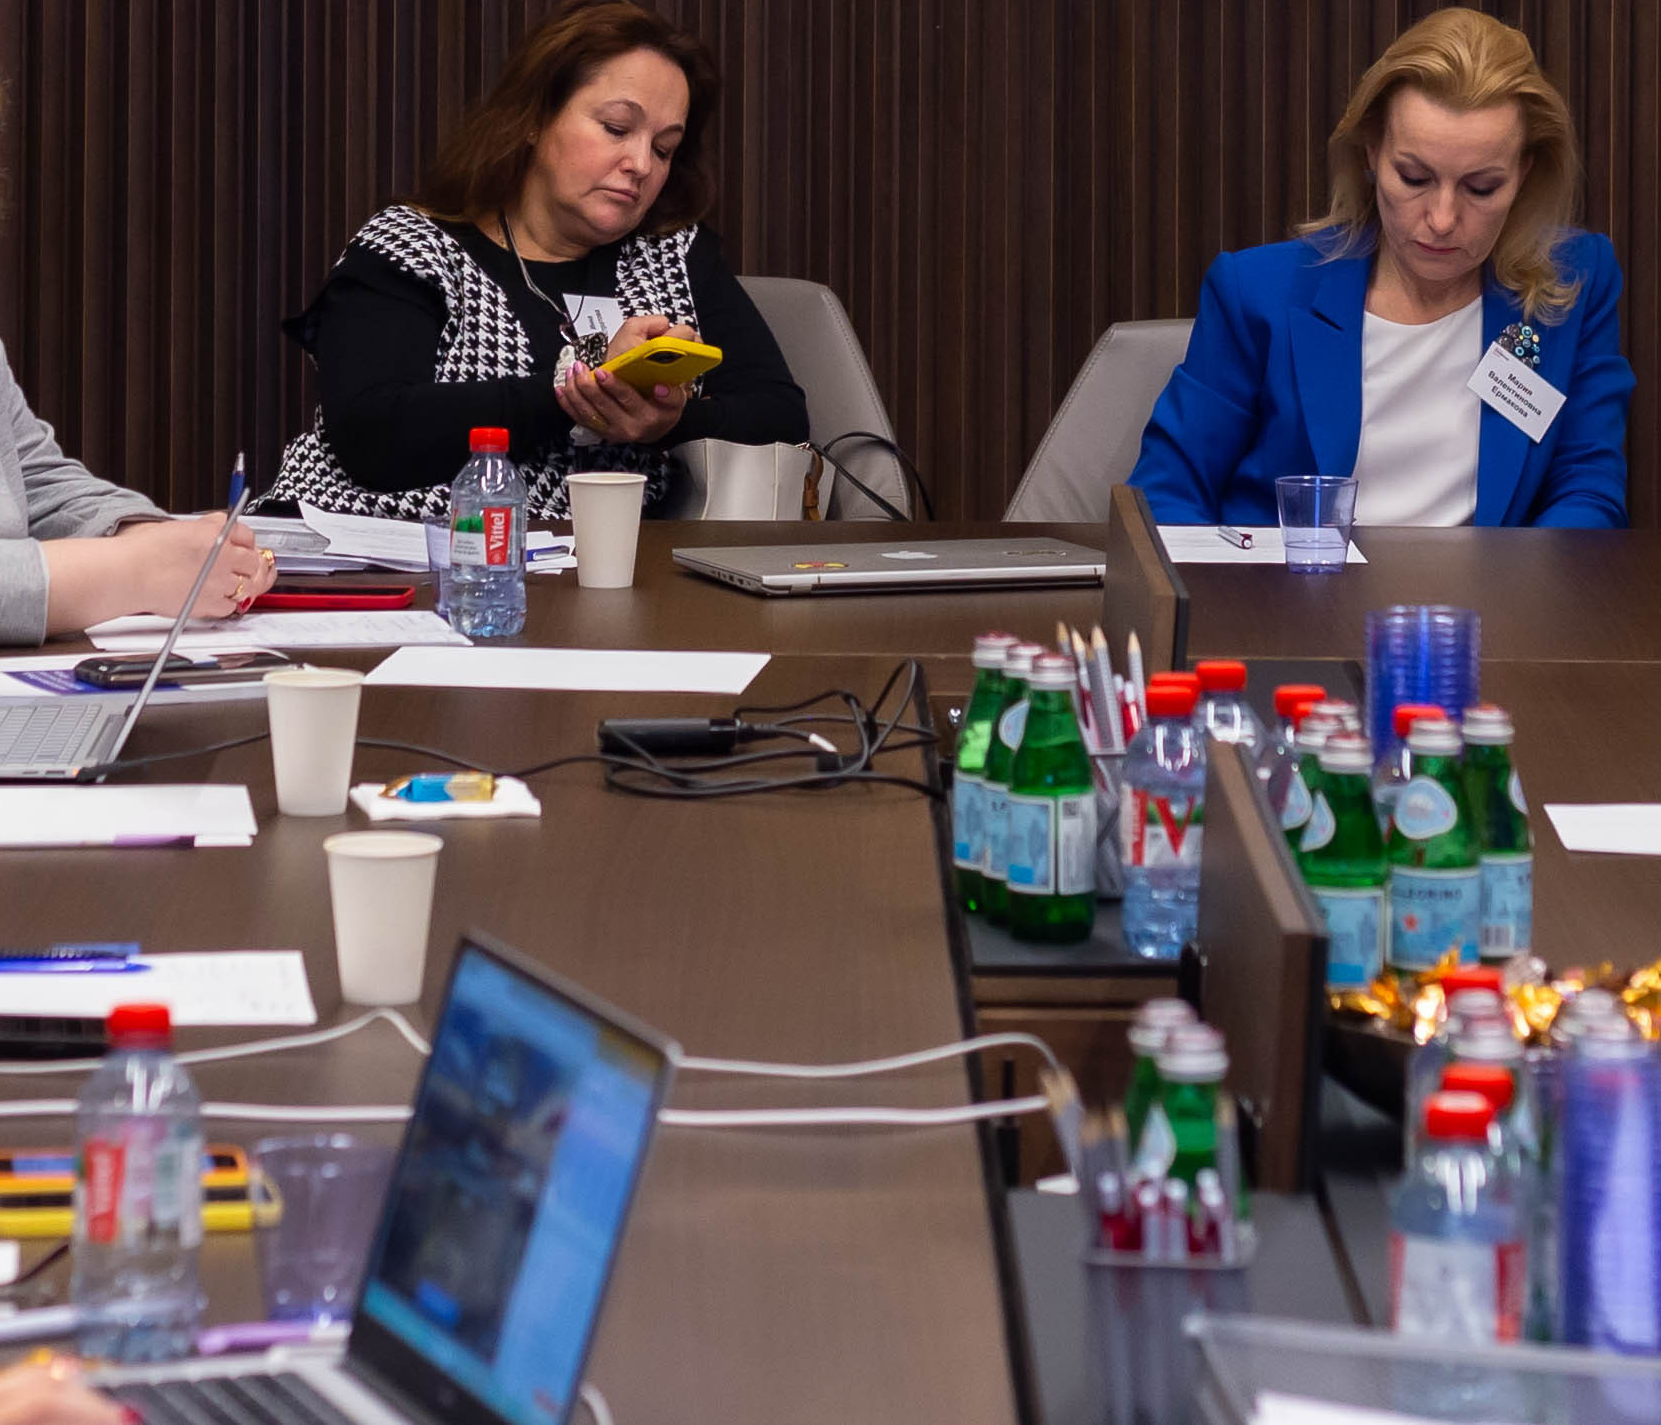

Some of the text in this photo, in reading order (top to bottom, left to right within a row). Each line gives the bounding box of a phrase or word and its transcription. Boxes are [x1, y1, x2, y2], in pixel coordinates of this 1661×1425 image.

[1487, 370, 1543, 416] Валентиновна
[1491, 385, 1529, 419] Ермакова
[1507, 373, 1533, 397] Мария
[489, 512, 506, 552] Vittel
